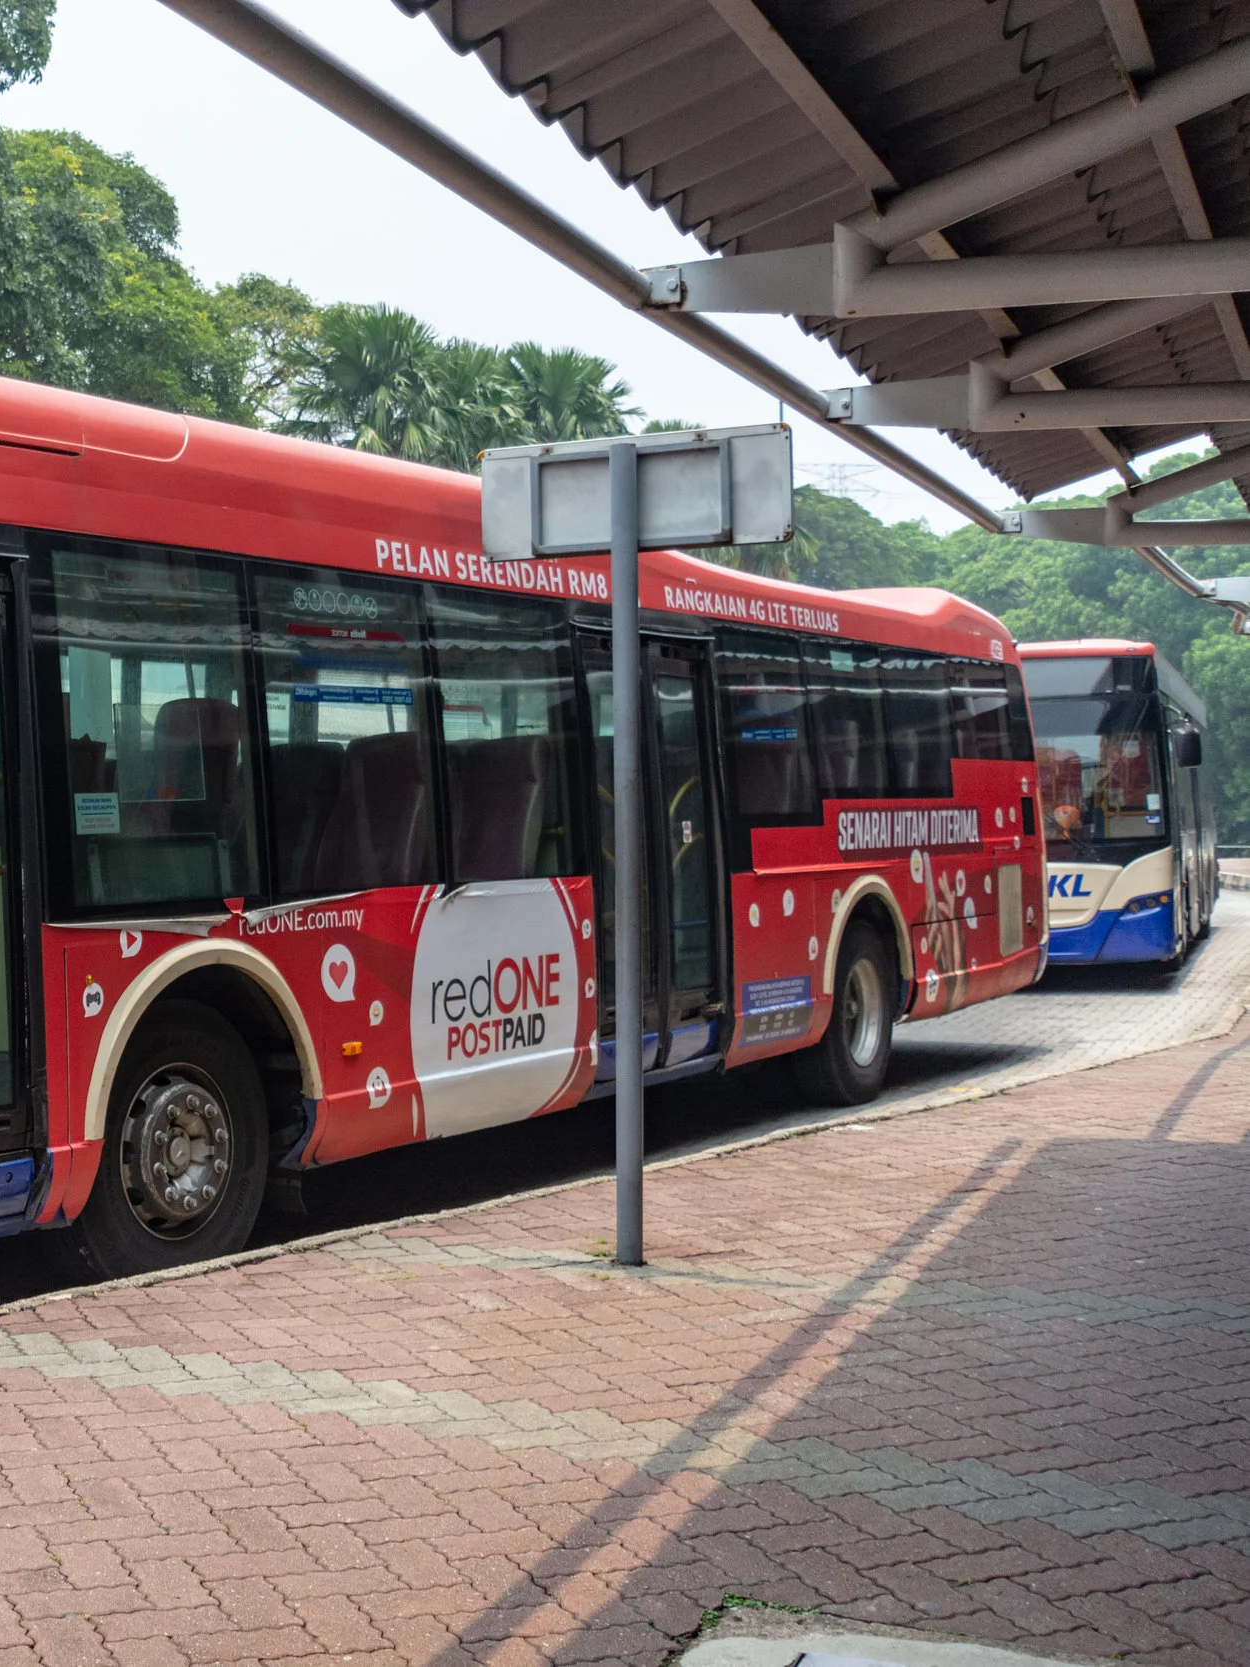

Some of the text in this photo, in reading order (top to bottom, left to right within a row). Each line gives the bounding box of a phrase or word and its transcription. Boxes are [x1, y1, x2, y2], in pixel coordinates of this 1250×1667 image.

[375, 539, 450, 578] PELAN
[455, 551, 564, 594] SERENDAH
[663, 585, 840, 633] RANGKAIAN 4G LTE TERLUAS
[838, 808, 980, 851] SENARAI HITAM DITERIMA
[431, 953, 560, 1024] redONE
[447, 1012, 546, 1061] POSTPAID
